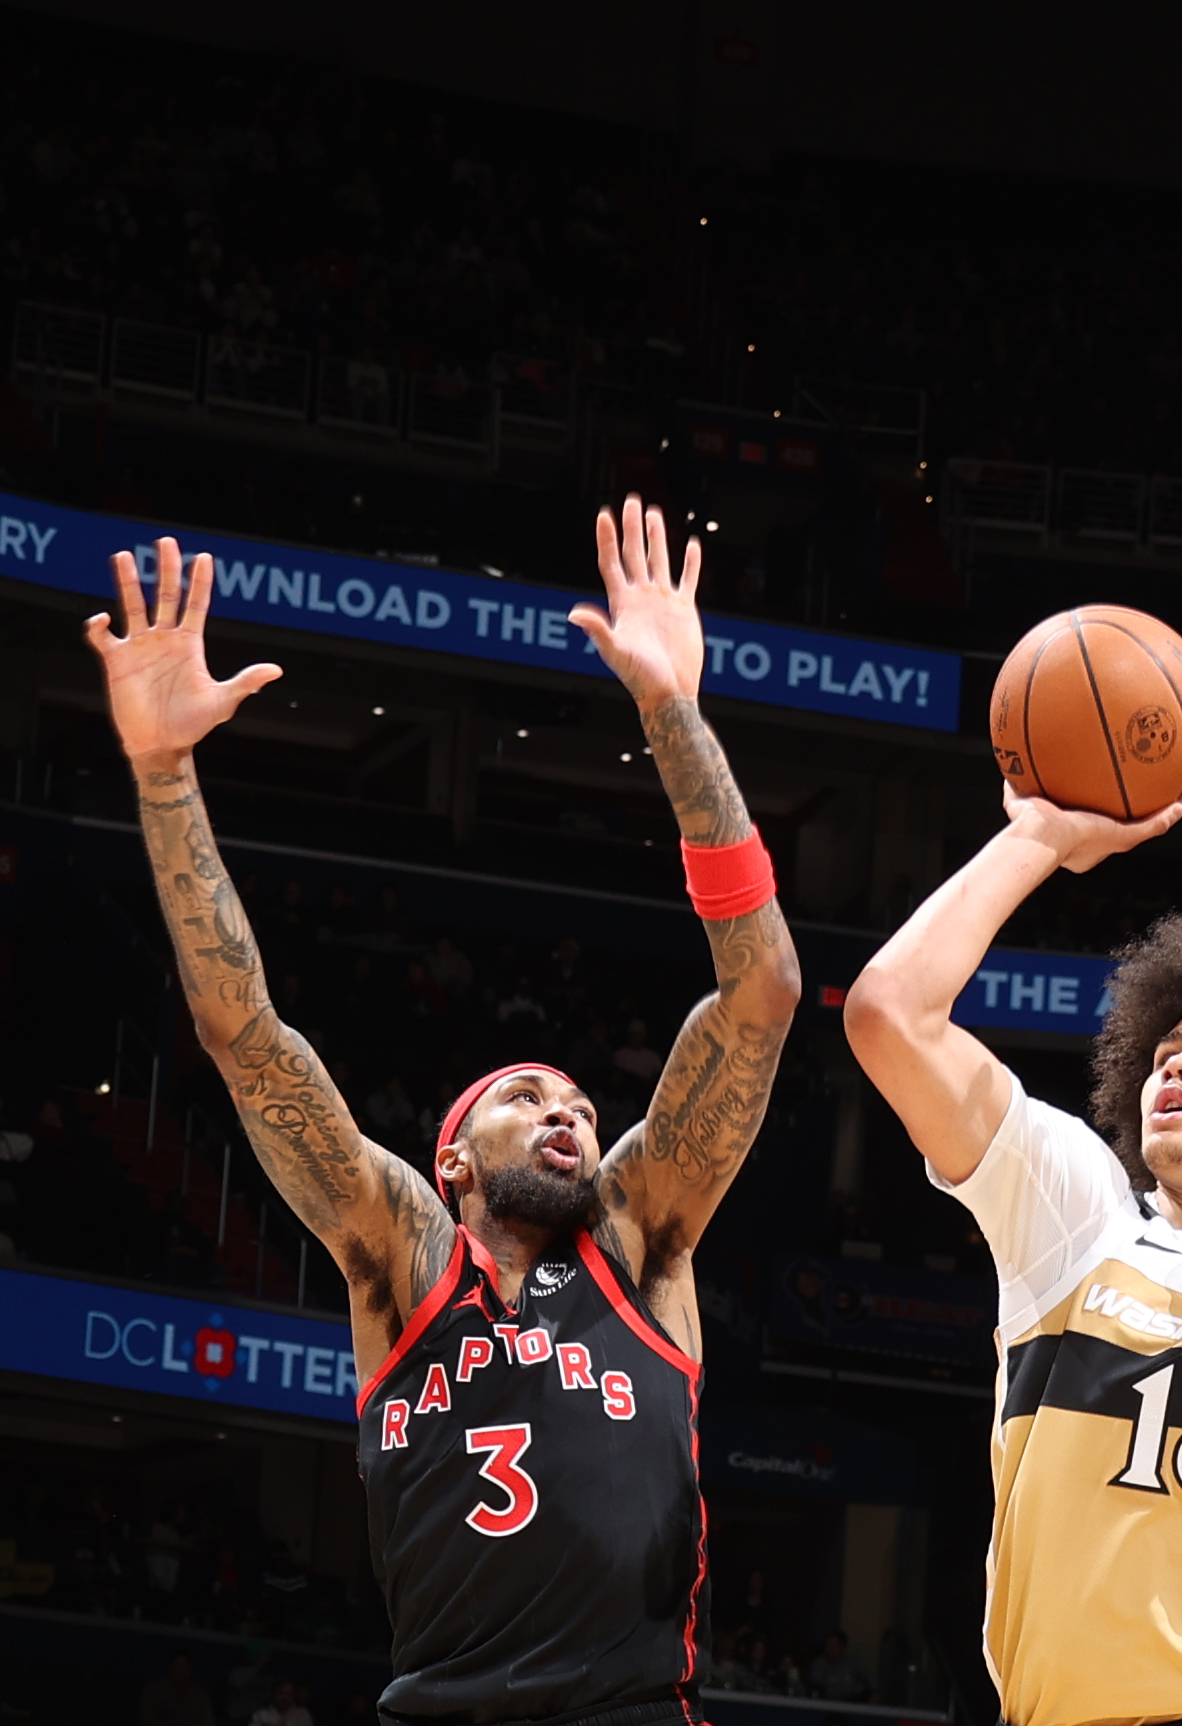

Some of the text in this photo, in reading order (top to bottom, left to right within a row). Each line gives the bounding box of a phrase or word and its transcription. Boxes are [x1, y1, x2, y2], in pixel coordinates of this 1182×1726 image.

[133, 543, 931, 709] DWNLOAD THE TO PLAY!
[976, 969, 1080, 1015] THE
[381, 1323, 637, 1451] RAPTORS
[465, 1422, 539, 1538] 3
